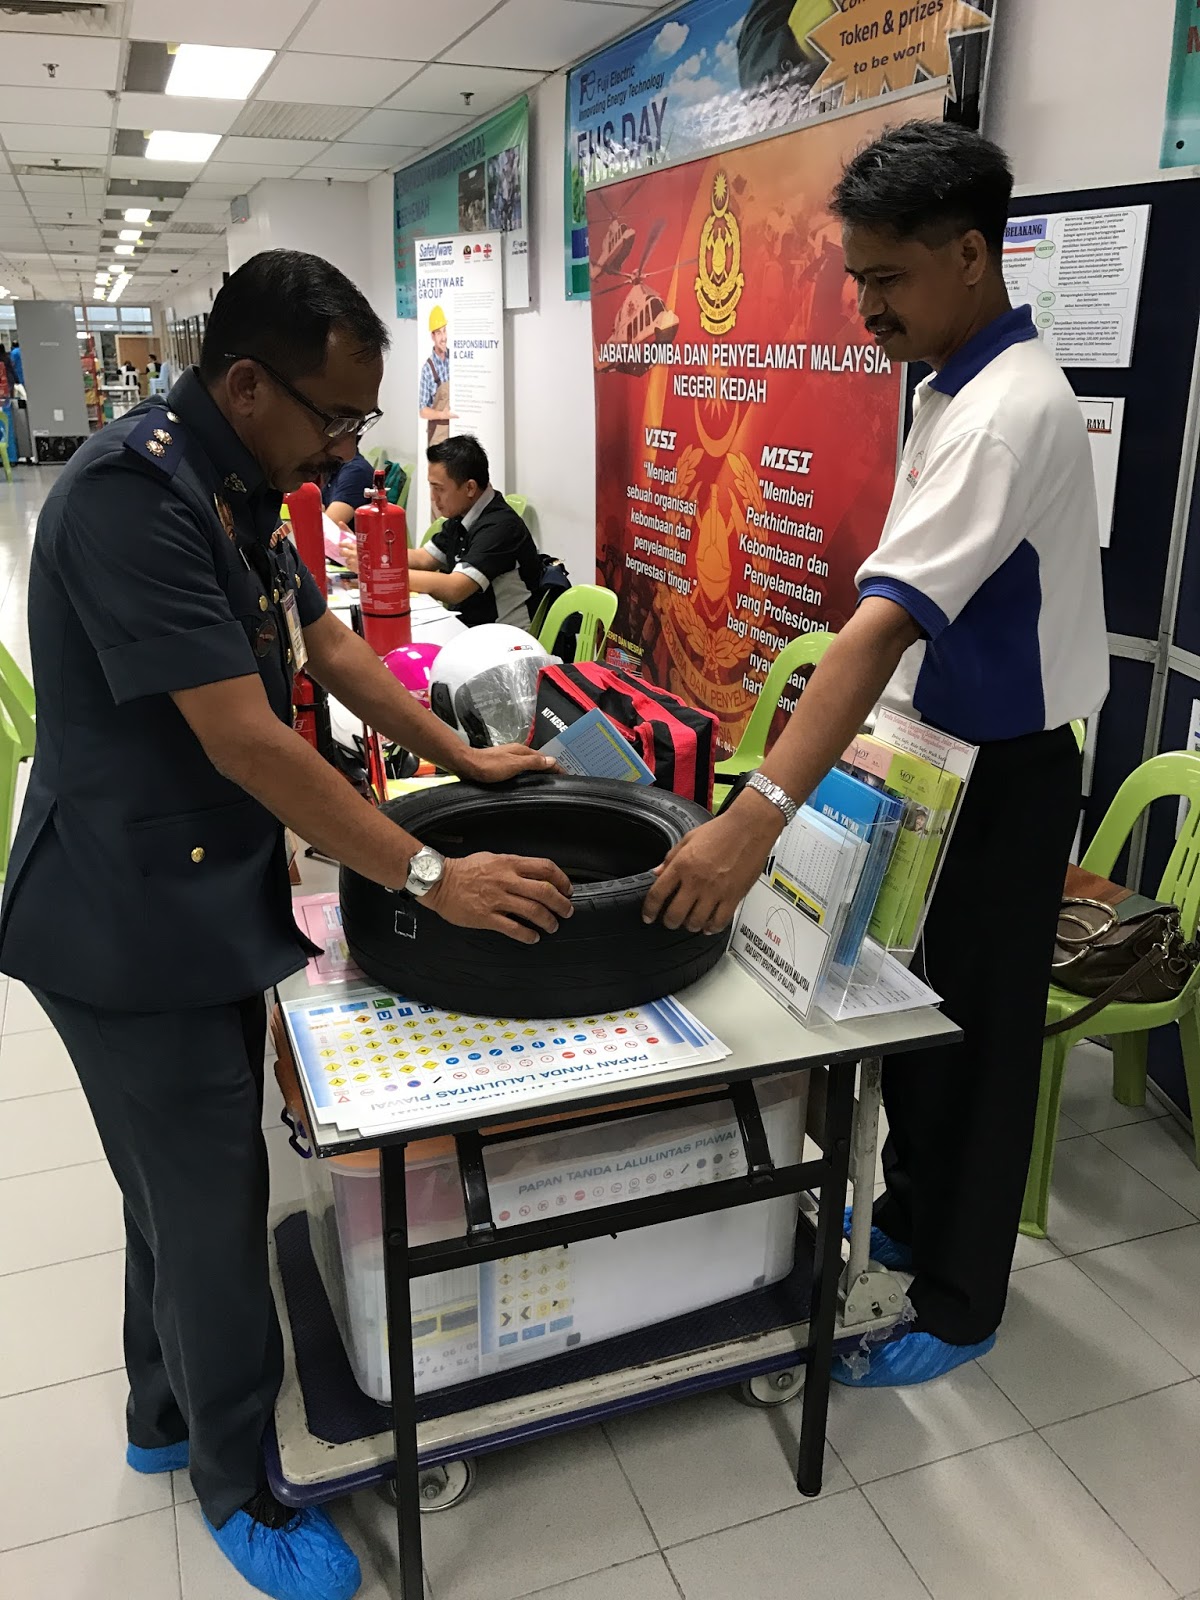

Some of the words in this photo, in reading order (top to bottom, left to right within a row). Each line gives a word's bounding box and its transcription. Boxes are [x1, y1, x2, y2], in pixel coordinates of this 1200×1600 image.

[840, 21, 878, 46] Token
[882, 10, 894, 34] &
[898, 0, 944, 34] prizes
[854, 62, 868, 74] to
[872, 56, 888, 69] be
[893, 40, 926, 62] won
[597, 75, 608, 94] Fuji
[610, 63, 636, 88] Electric
[606, 90, 626, 106] Energy
[628, 72, 665, 98] Technology
[622, 96, 668, 162] DAY
[418, 276, 464, 289] SAFETYWARE
[418, 288, 443, 300] GROUP
[454, 340, 500, 349] RESPONSIBILITY
[459, 351, 474, 360] CARE
[598, 343, 641, 364] JABATAN
[643, 344, 682, 366] BOMBA
[684, 344, 708, 366] DAN
[712, 344, 806, 370] PENYELAMAT
[810, 345, 892, 374] MALAYSIA
[673, 375, 716, 399] NEGERI
[720, 378, 767, 404] KEDAH
[1087, 418, 1106, 429] RAYA
[644, 428, 677, 450] VISI
[760, 446, 814, 474] MISI
[626, 484, 652, 504] sebuah
[654, 492, 697, 516] organisasi
[630, 507, 674, 536] kebombaan
[676, 523, 691, 542] dan
[746, 506, 824, 544] Perkhidmatan
[634, 536, 686, 566] penyelamatan
[738, 534, 804, 570] Kebombaan
[806, 554, 829, 578] dan
[626, 552, 666, 582] berprestasi
[743, 563, 822, 607] Penyelamatan
[735, 591, 760, 618] yang
[763, 604, 829, 633] Profesional
[726, 613, 749, 639] bagi
[750, 626, 788, 652] menyel
[750, 653, 774, 672] nya
[710, 690, 752, 709] PENYELA
[742, 672, 763, 697] hart
[778, 694, 798, 714] end
[541, 707, 554, 718] KIT
[550, 715, 568, 733] KESE
[718, 726, 734, 744] SIA
[822, 804, 839, 822] BILA
[840, 814, 860, 834] TAYAR
[764, 928, 782, 946] JKJR
[540, 1064, 594, 1078] TANDA
[598, 1054, 648, 1068] PAPAN
[436, 1074, 536, 1098] LALULINTAS
[371, 1094, 430, 1110] PIAWAI
[518, 1175, 562, 1194] PAPAN
[566, 1164, 612, 1182] TANDA
[616, 1144, 691, 1172] LALULINTAS
[695, 1130, 736, 1150] PIAWAI
